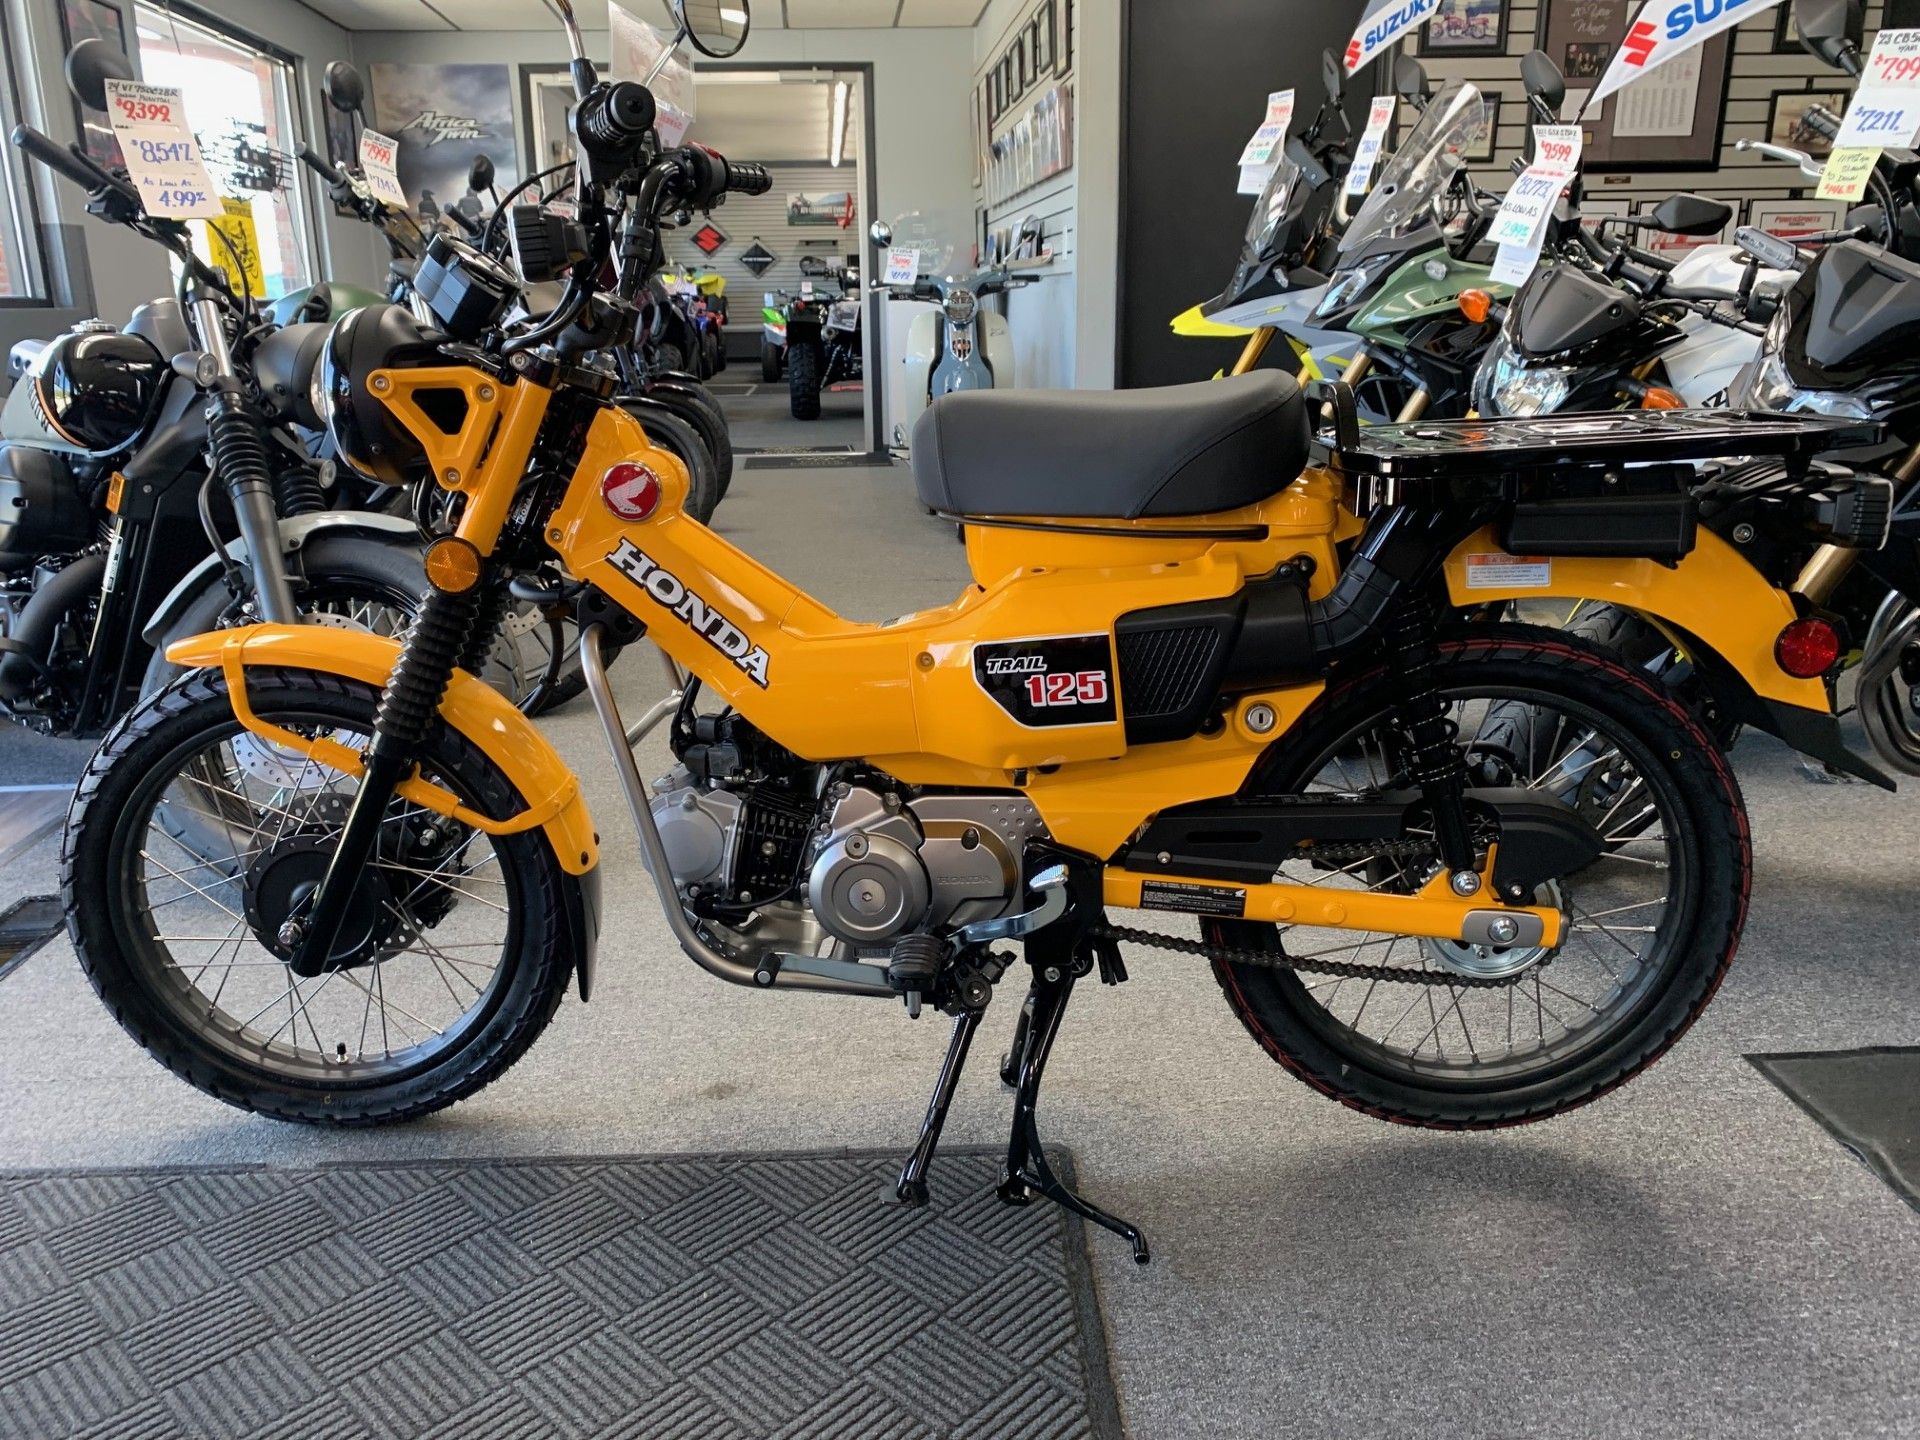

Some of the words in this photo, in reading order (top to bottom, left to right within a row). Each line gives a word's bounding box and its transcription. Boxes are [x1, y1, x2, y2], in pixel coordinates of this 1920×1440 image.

[400, 110, 482, 130] Africa
[427, 126, 489, 146] Twin
[605, 536, 770, 690] HONDA
[986, 656, 1048, 674] TRAIL
[1024, 670, 1108, 707] 125
